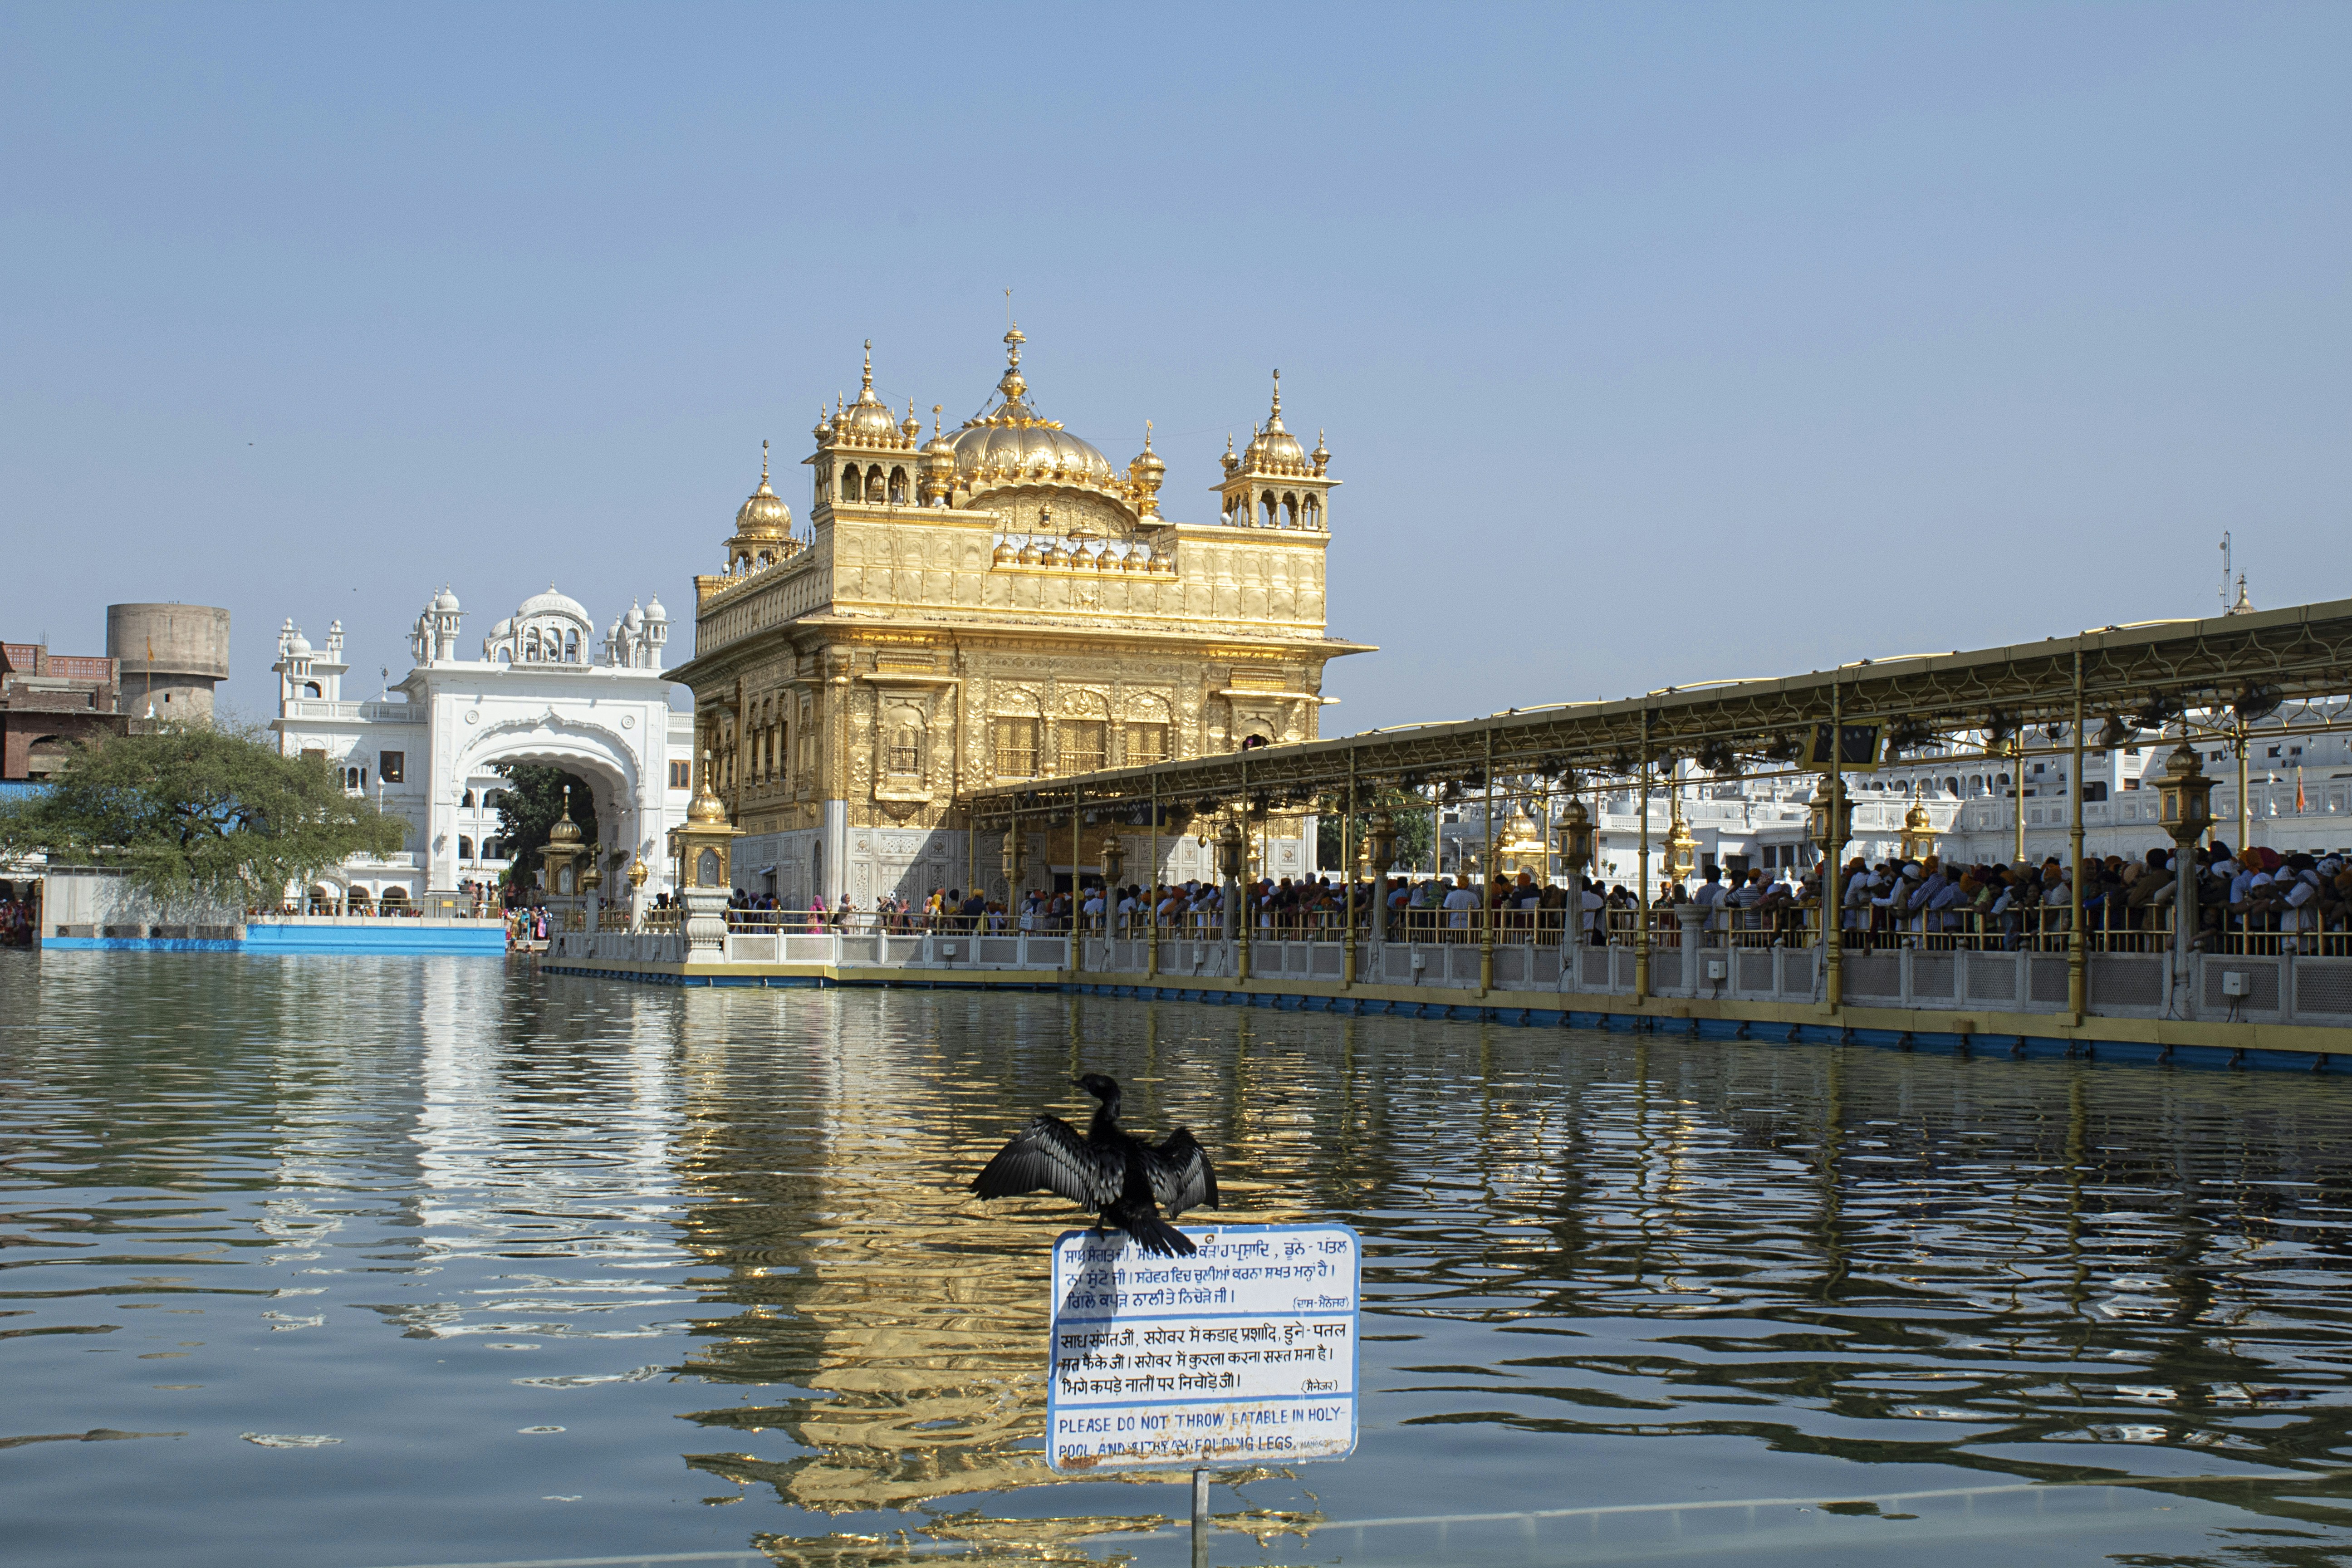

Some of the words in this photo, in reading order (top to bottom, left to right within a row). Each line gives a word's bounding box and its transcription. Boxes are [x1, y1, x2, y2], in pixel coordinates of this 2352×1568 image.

[1135, 1267, 1169, 1284] ਸਰੋਵਰ
[1171, 1266, 1191, 1282] ਵਿਚ
[1232, 1268, 1262, 1280] ਕਰਨਾ
[1265, 1266, 1290, 1279] ਸਖਤ
[1061, 1334, 1088, 1348] साध
[1089, 1329, 1119, 1347] संगत
[1144, 1326, 1186, 1344] सरोवर
[1189, 1325, 1200, 1343] में
[1313, 1323, 1346, 1337] पतल
[1135, 1351, 1173, 1368] सरोवर
[1176, 1350, 1187, 1367] में
[1189, 1352, 1225, 1370] कुरला
[1228, 1350, 1260, 1364] करना
[1294, 1348, 1316, 1361] मना
[1156, 1377, 1175, 1392] पर
[1059, 1417, 1111, 1433] PLEASE
[1117, 1416, 1135, 1431] DO
[1141, 1415, 1168, 1429] NOT
[1175, 1412, 1225, 1428] THROW
[1232, 1409, 1288, 1425] EATABLE
[1293, 1409, 1304, 1422] IN
[1059, 1443, 1091, 1458] POOL
[1098, 1442, 1125, 1456] AND
[1195, 1436, 1253, 1453] FOLDING
